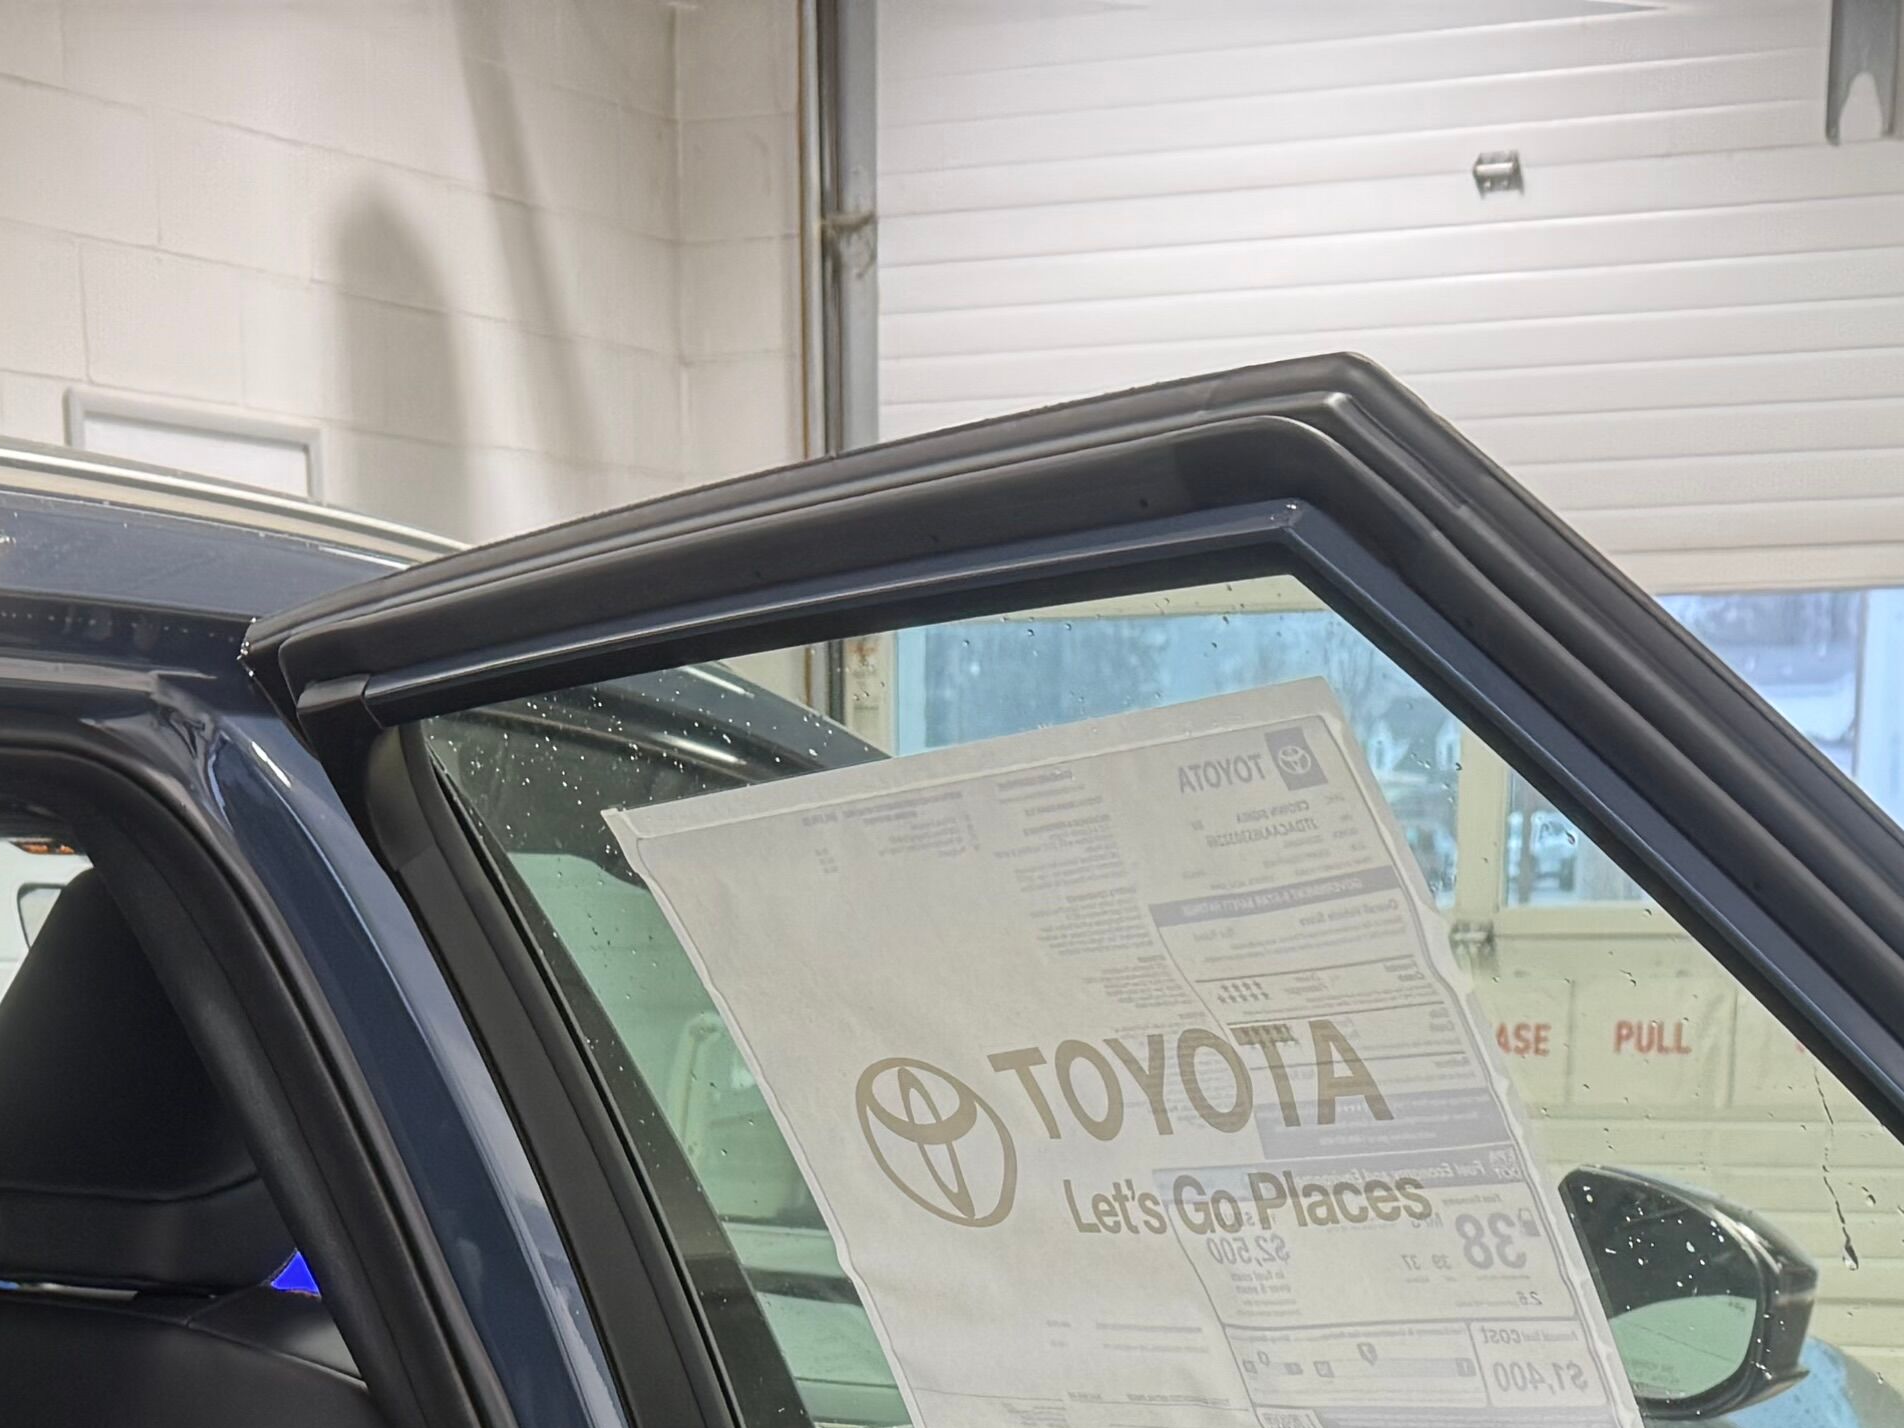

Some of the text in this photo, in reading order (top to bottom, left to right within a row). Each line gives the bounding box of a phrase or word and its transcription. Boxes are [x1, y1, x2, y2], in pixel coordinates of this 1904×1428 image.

[1494, 1019, 1693, 1056] ASE PULL
[985, 1018, 1395, 1142] TOYOTA
[1063, 1169, 1435, 1236] Let's Go Places
